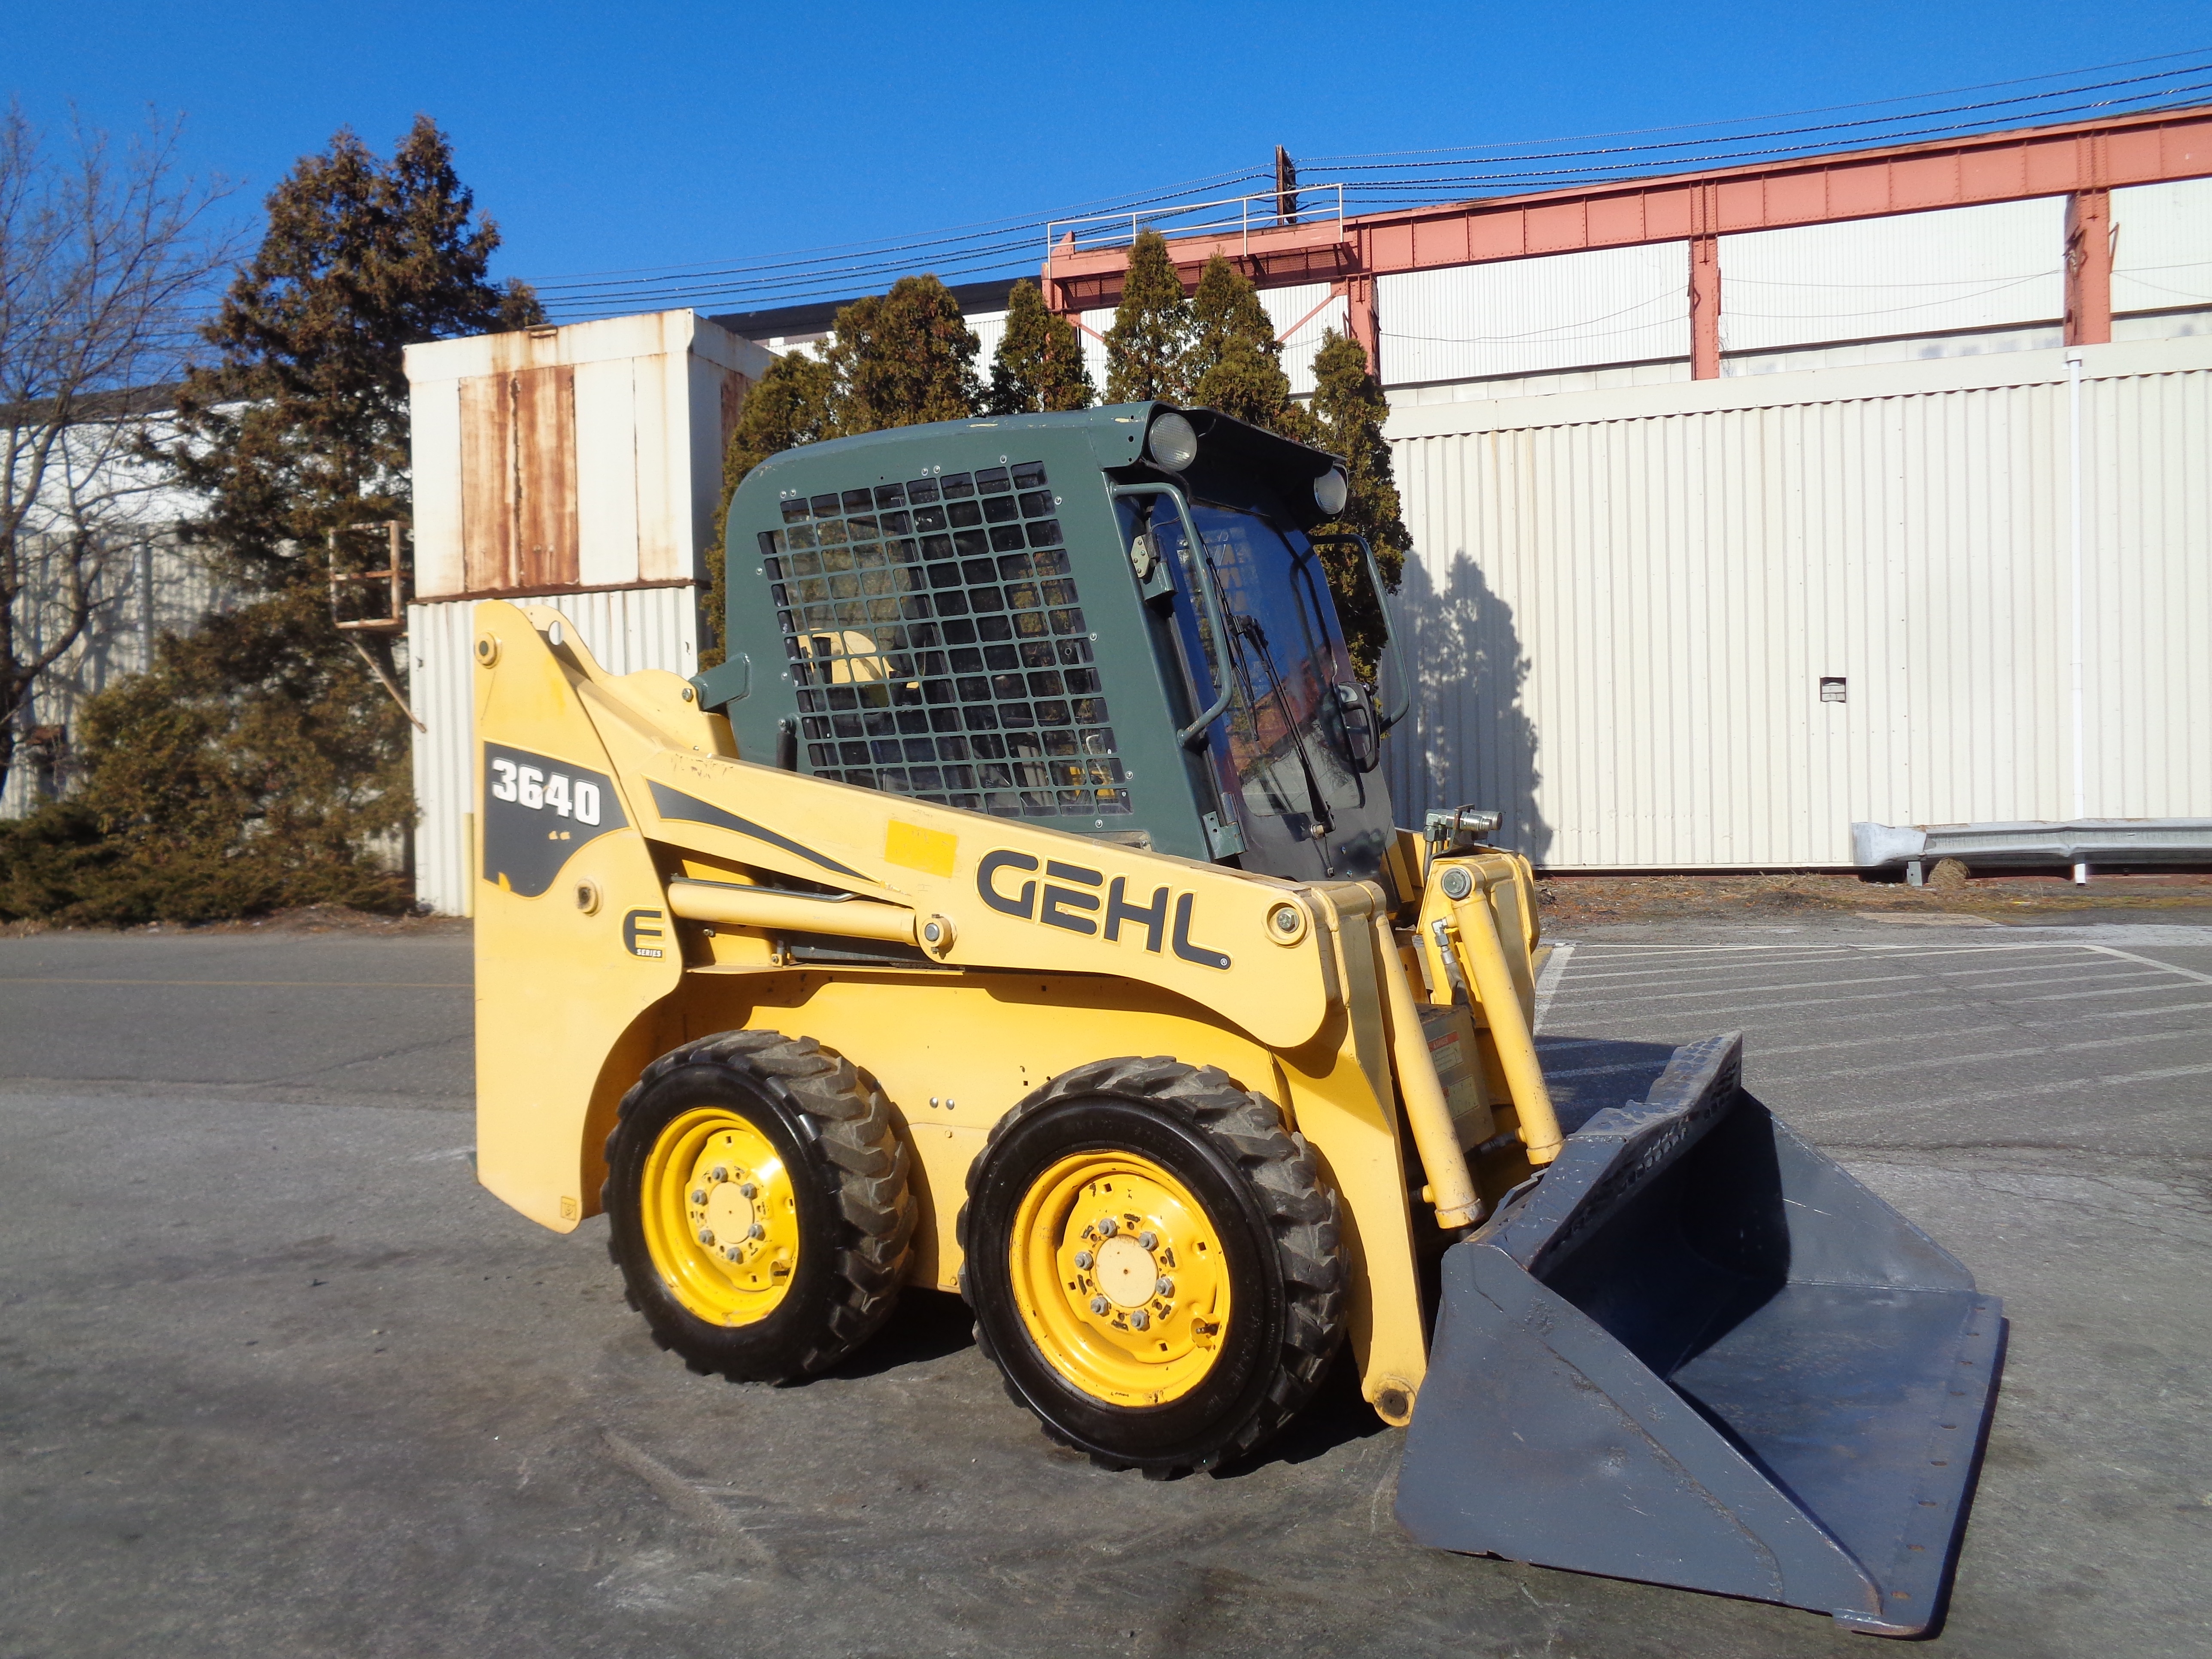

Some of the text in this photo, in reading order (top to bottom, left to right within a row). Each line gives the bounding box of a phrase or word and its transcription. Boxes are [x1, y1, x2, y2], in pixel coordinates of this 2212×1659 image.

[492, 757, 601, 826] 3640
[623, 909, 662, 958] E
[977, 849, 1232, 971] GEHL
[637, 948, 661, 957] SERIES
